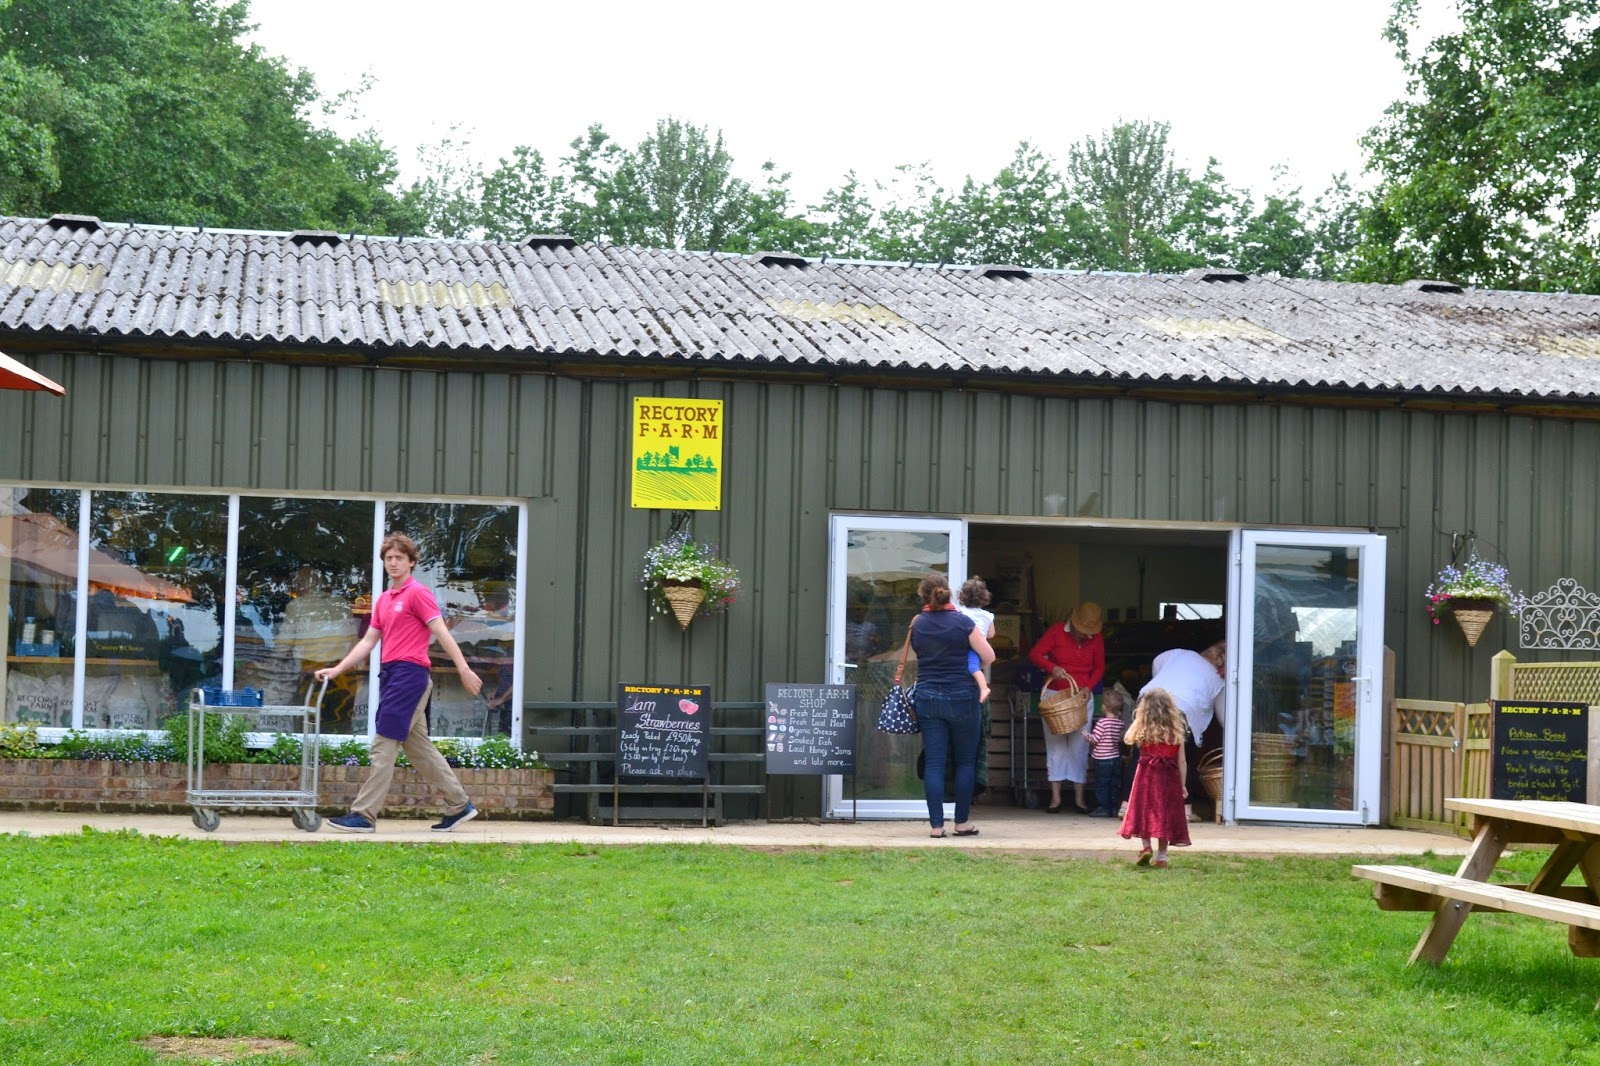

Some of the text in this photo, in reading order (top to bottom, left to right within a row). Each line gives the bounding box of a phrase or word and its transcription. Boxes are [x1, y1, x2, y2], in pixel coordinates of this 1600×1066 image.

[640, 405, 718, 422] RECTORY
[778, 688, 814, 698] RECTORY
[625, 696, 656, 712] Jam
[799, 699, 826, 708] SHOP
[812, 709, 827, 717] Local
[832, 709, 853, 719] Bread
[636, 713, 700, 730] Strawberries
[812, 718, 826, 726] Local
[830, 719, 846, 727] Meat
[621, 730, 640, 742] Ready
[644, 732, 661, 740] Picked
[788, 726, 837, 736] Organic Cheese
[1543, 728, 1566, 740] Bread
[788, 736, 832, 745] Smoked Fish
[648, 743, 661, 756] tray
[691, 746, 697, 756] kg
[810, 746, 827, 757] Honey
[1502, 746, 1519, 755] Now
[652, 753, 658, 763] kg
[662, 752, 671, 763] for
[812, 757, 824, 765] lots
[621, 763, 646, 774] Please
[649, 764, 662, 775] ask
[677, 766, 696, 777] shop
